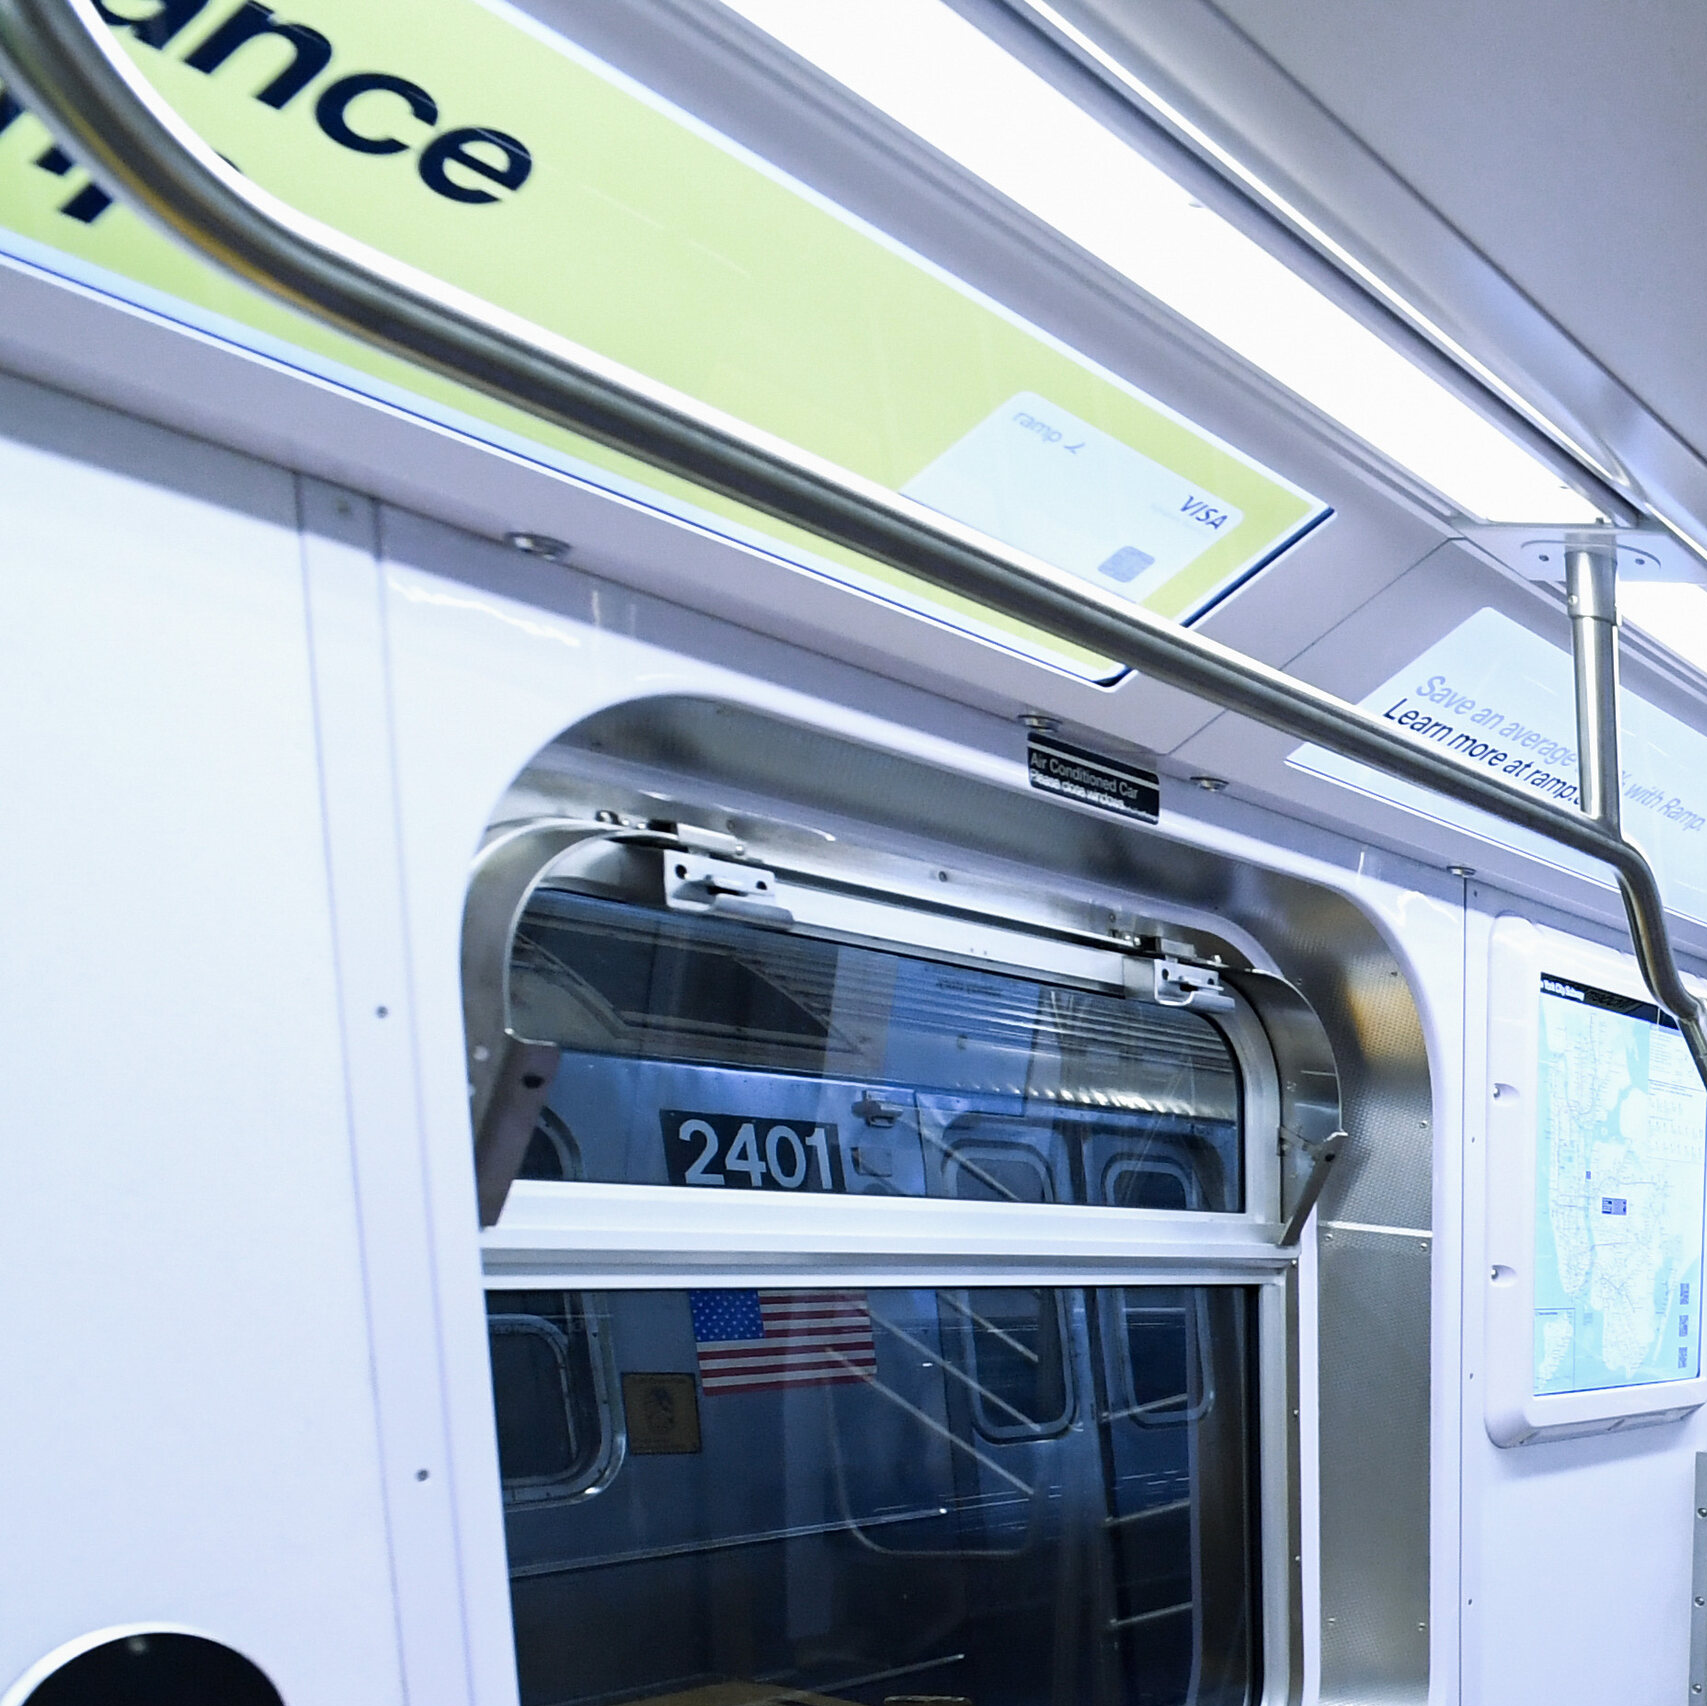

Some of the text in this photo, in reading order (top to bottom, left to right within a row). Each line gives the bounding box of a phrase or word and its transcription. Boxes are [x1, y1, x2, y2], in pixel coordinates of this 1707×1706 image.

[1012, 411, 1064, 444] ramp
[1180, 494, 1229, 531] VISA
[1382, 697, 1454, 743] Learn
[1446, 732, 1510, 767] more
[1502, 760, 1536, 779] at
[1415, 675, 1578, 767] Save an average
[1030, 752, 1140, 800] Air Conditioned Car
[678, 1118, 833, 1190] 2401
